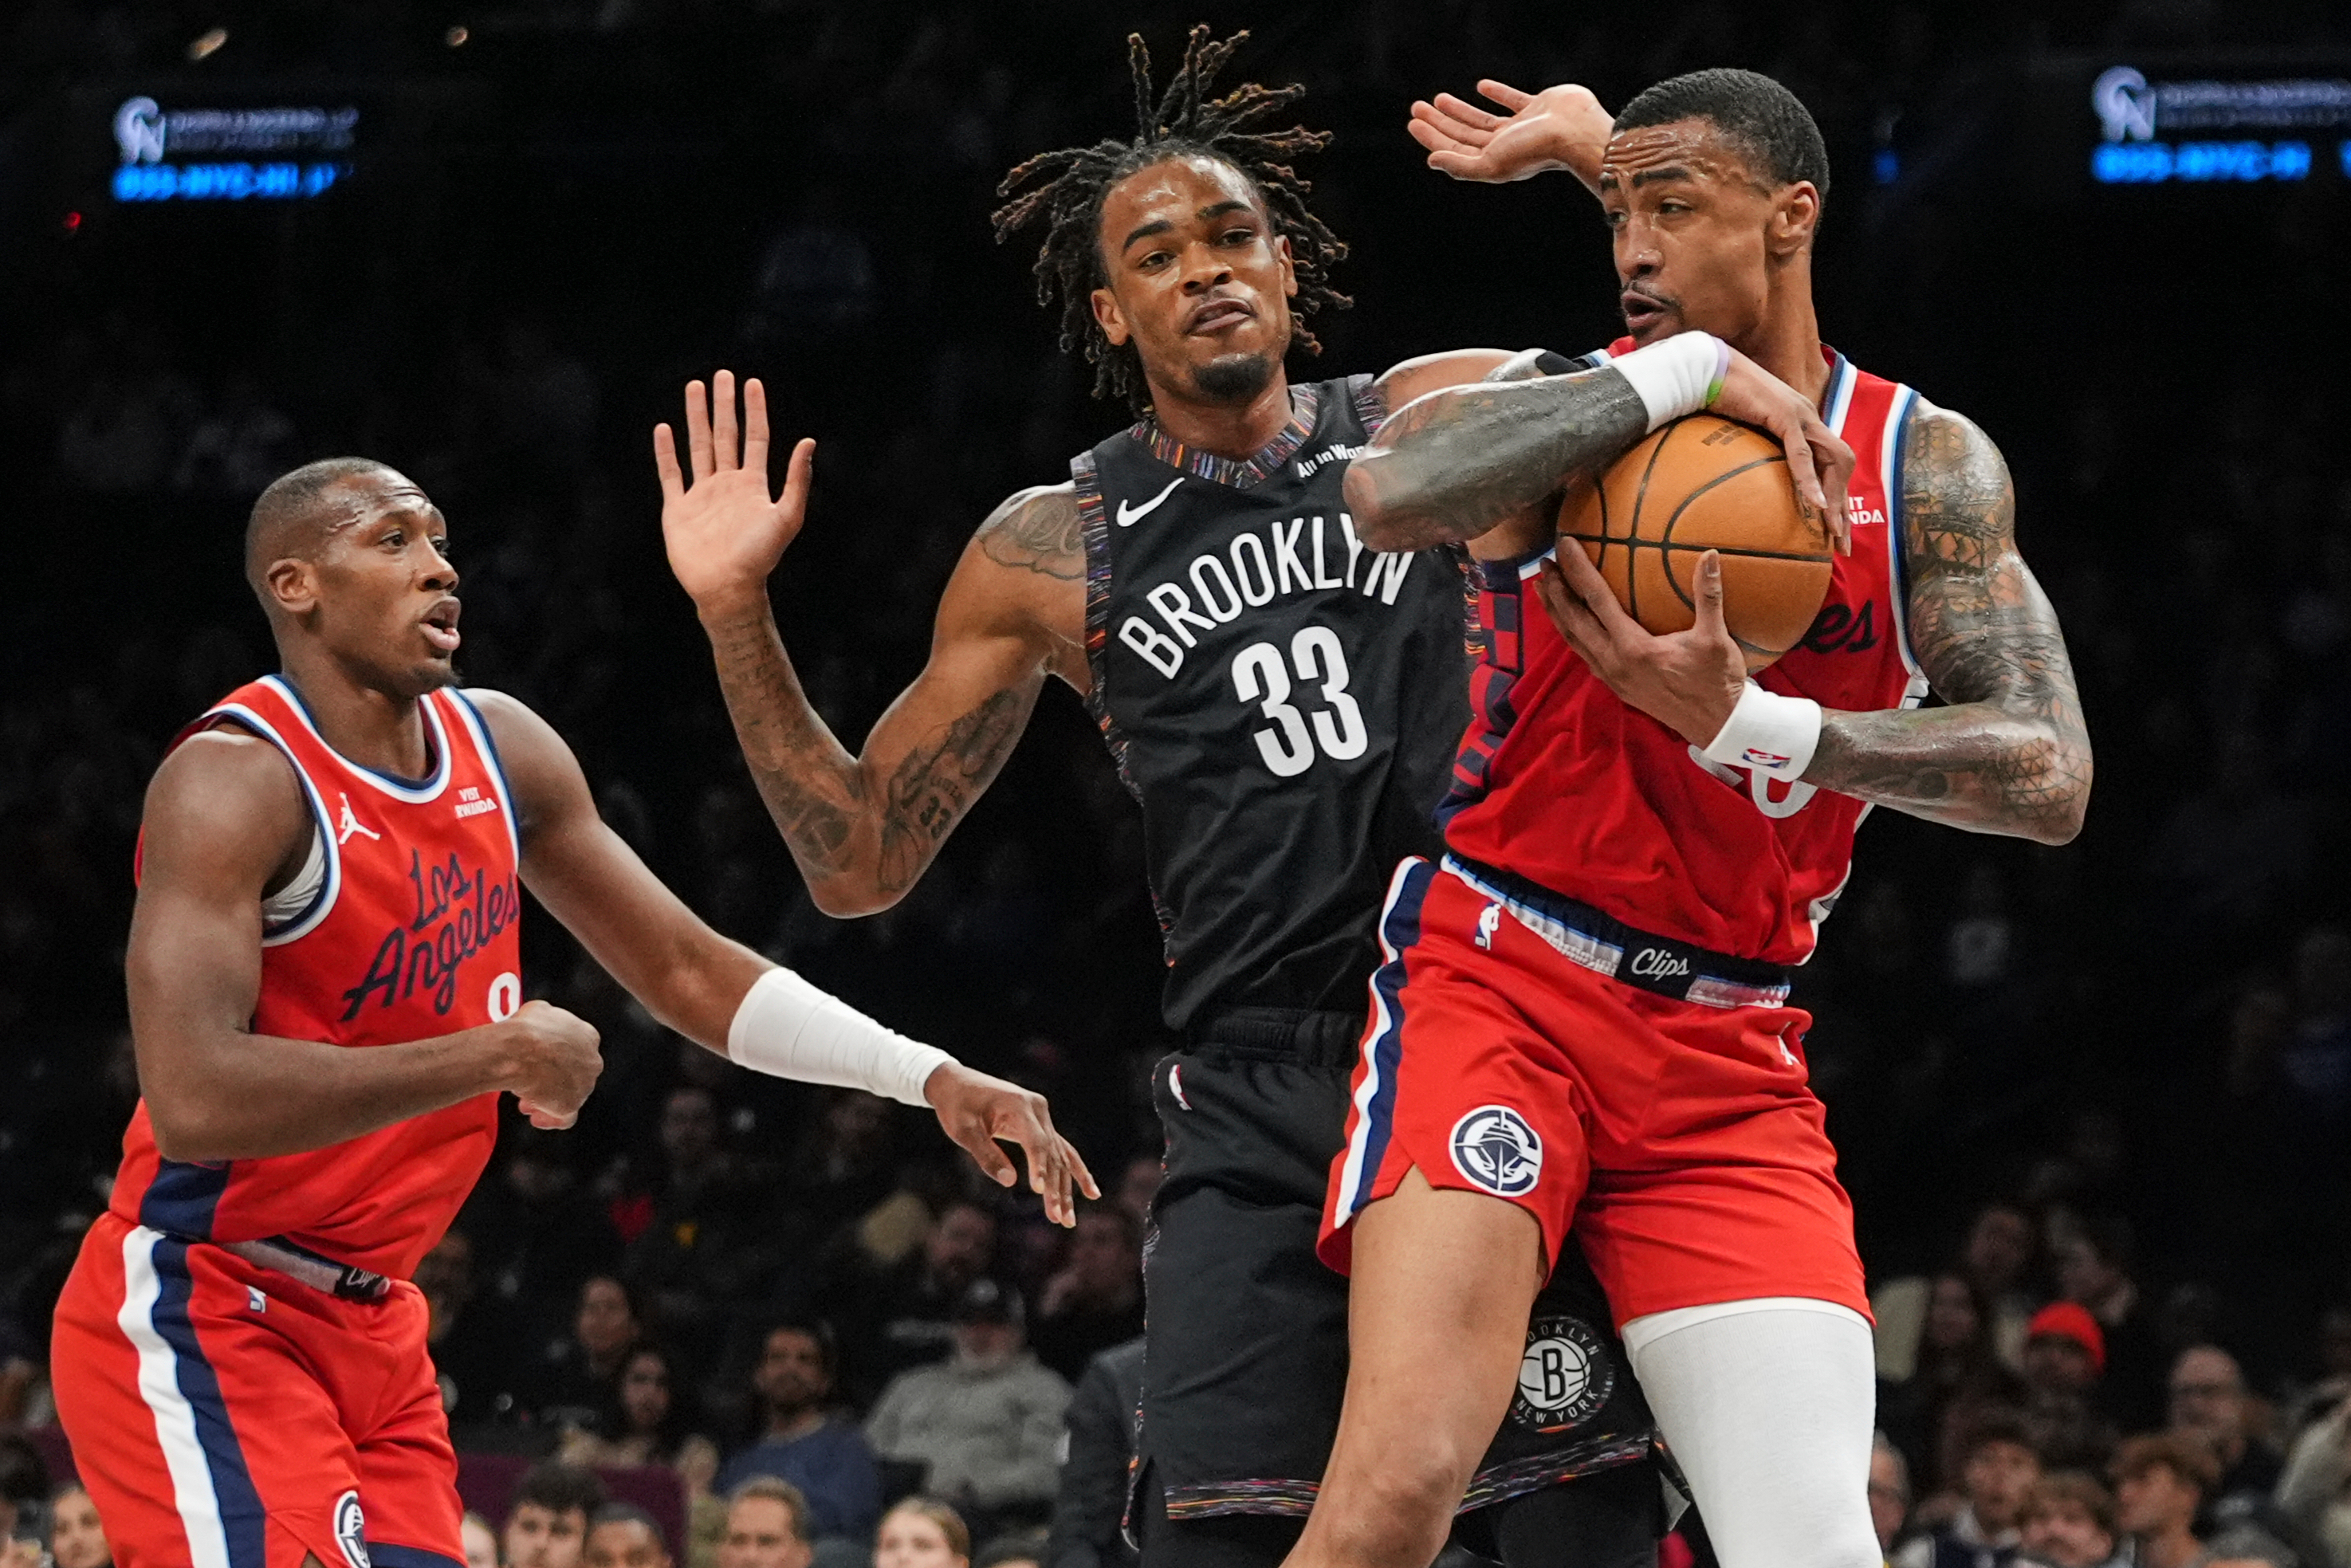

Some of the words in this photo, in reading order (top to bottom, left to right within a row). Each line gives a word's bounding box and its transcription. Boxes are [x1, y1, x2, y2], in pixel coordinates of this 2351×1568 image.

[1297, 460, 1318, 477] All
[1315, 450, 1335, 464] In
[1118, 513, 1414, 679] BROOKLYN
[1231, 626, 1368, 777] 33
[409, 847, 471, 931] Los
[340, 868, 519, 1021] Angeles
[1631, 948, 1690, 981] Clips
[1527, 1324, 1599, 1355] OOKLYN
[1541, 1348, 1566, 1401] B
[1516, 1399, 1547, 1424] NEW
[1555, 1389, 1598, 1422] YORK
